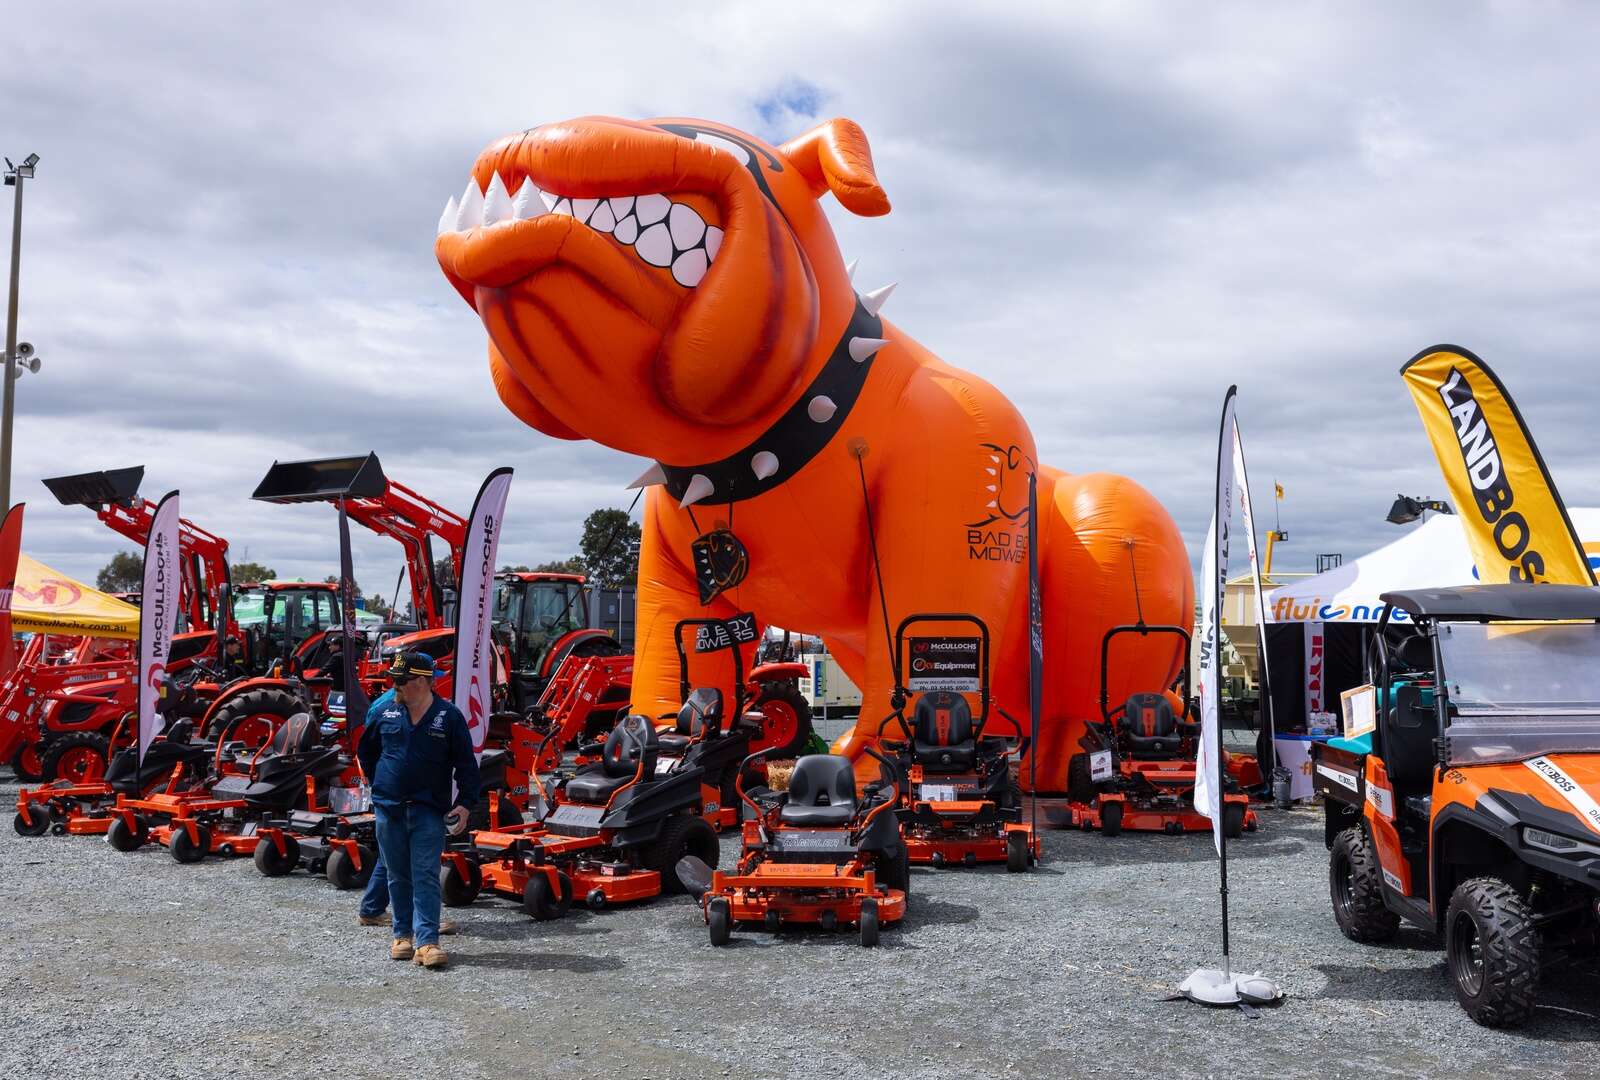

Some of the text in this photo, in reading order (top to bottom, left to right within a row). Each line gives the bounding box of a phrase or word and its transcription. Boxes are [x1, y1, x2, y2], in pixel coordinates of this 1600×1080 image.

[1440, 370, 1549, 584] LANDBOS
[967, 530, 1010, 546] BAD
[153, 532, 165, 658] McCULLOCHS
[472, 514, 493, 668] McCULLOCHS
[1448, 768, 1467, 784] EPS
[1532, 759, 1576, 792] LANDBOSS
[1588, 809, 1600, 825] DIE
